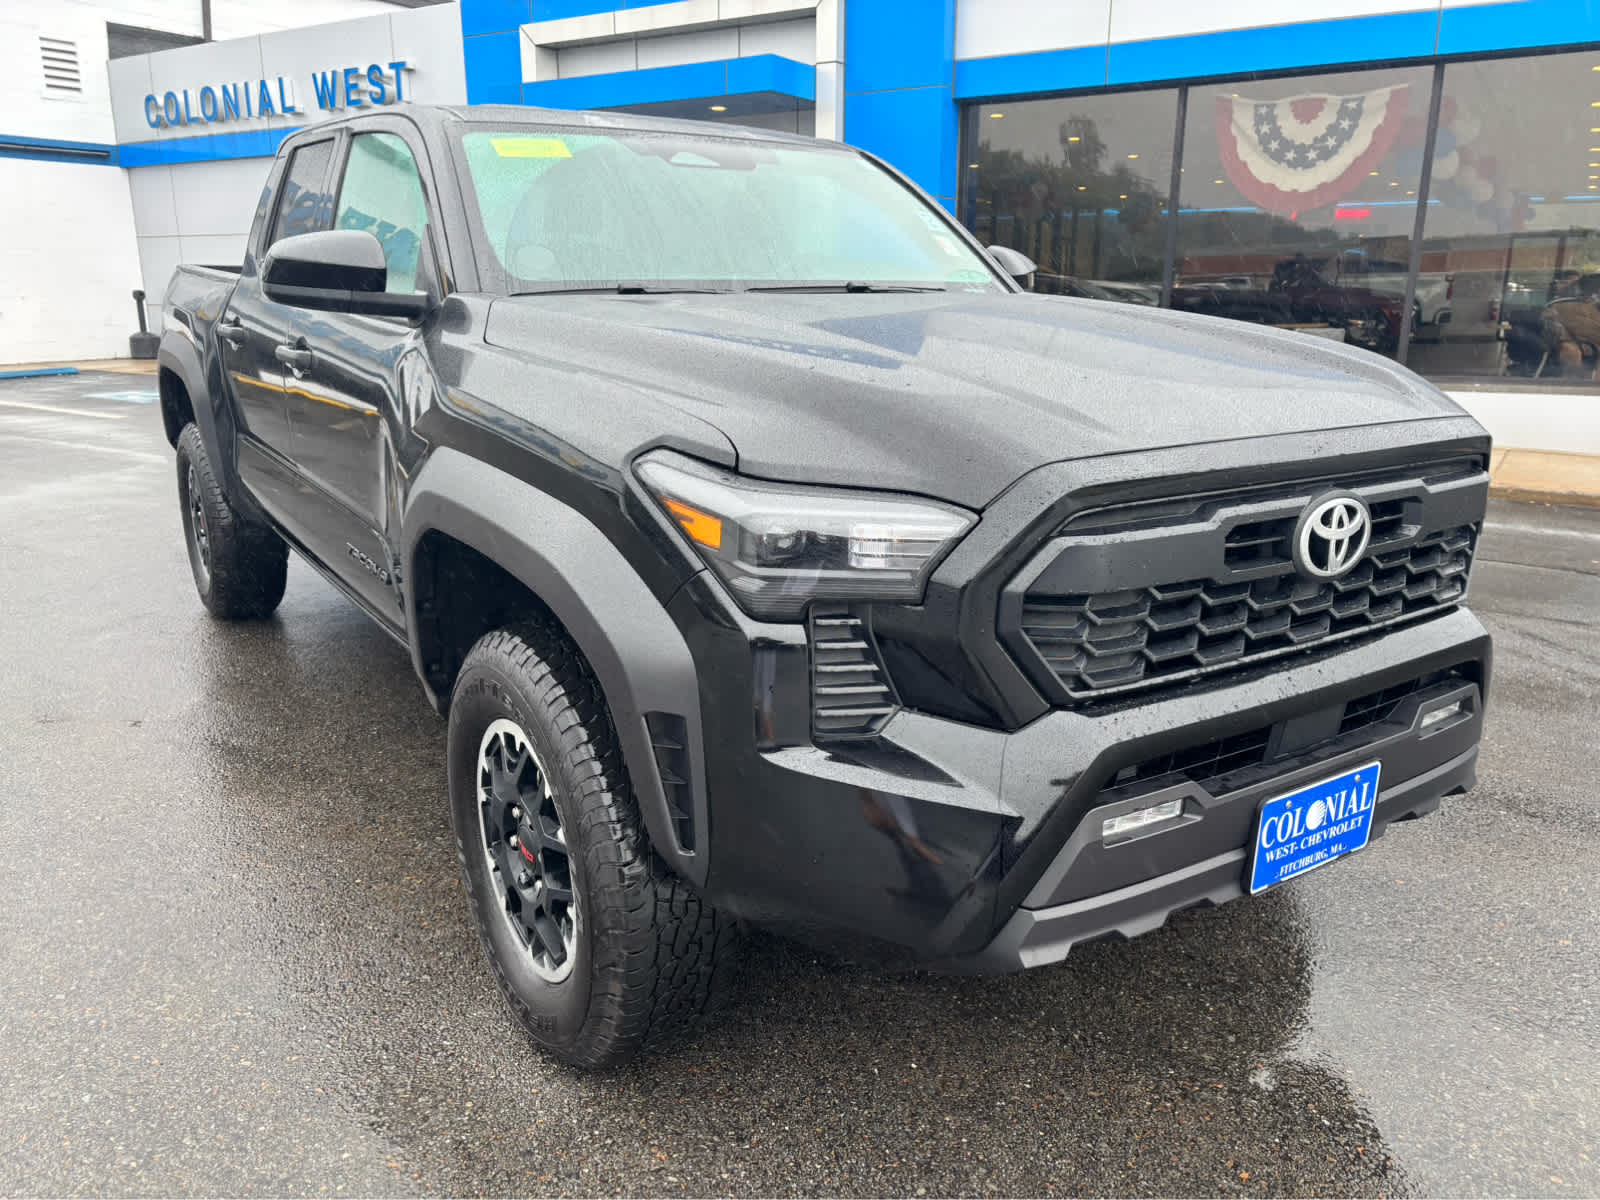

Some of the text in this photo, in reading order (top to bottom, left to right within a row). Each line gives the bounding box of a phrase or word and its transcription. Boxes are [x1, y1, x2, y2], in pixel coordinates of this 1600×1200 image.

[144, 61, 407, 128] COLONIAL WEST
[1261, 782, 1372, 848] COLONIAL
